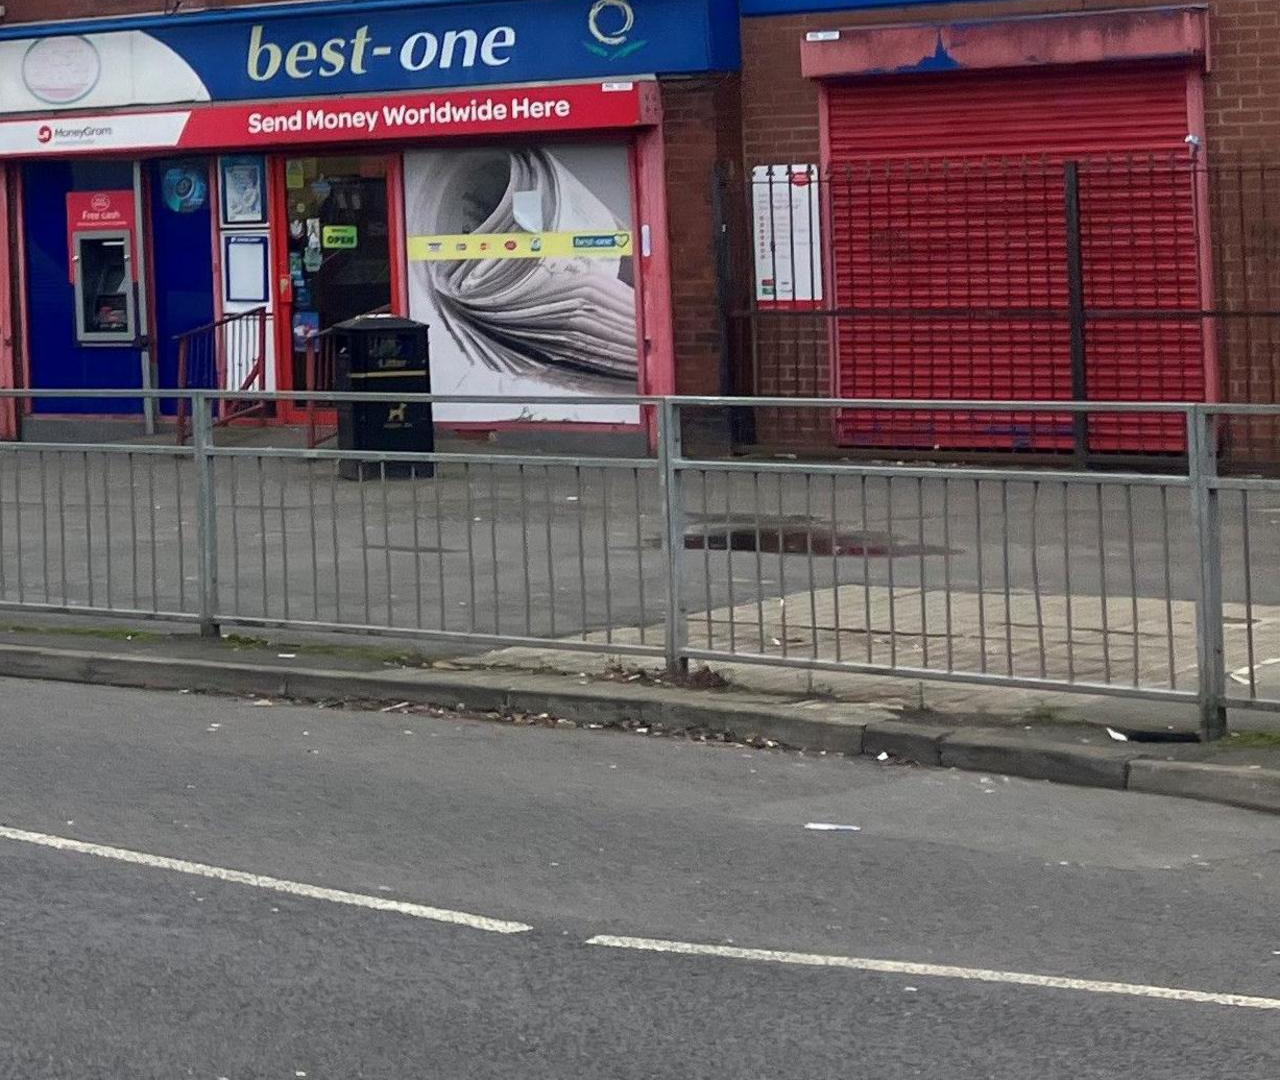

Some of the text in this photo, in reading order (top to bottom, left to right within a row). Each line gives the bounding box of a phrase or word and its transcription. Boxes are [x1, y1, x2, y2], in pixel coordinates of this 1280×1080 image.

[247, 98, 571, 133] Send Money Worldwide Here
[54, 126, 113, 139] MoneyGram
[81, 210, 100, 220] Free
[326, 236, 355, 245] OPEN
